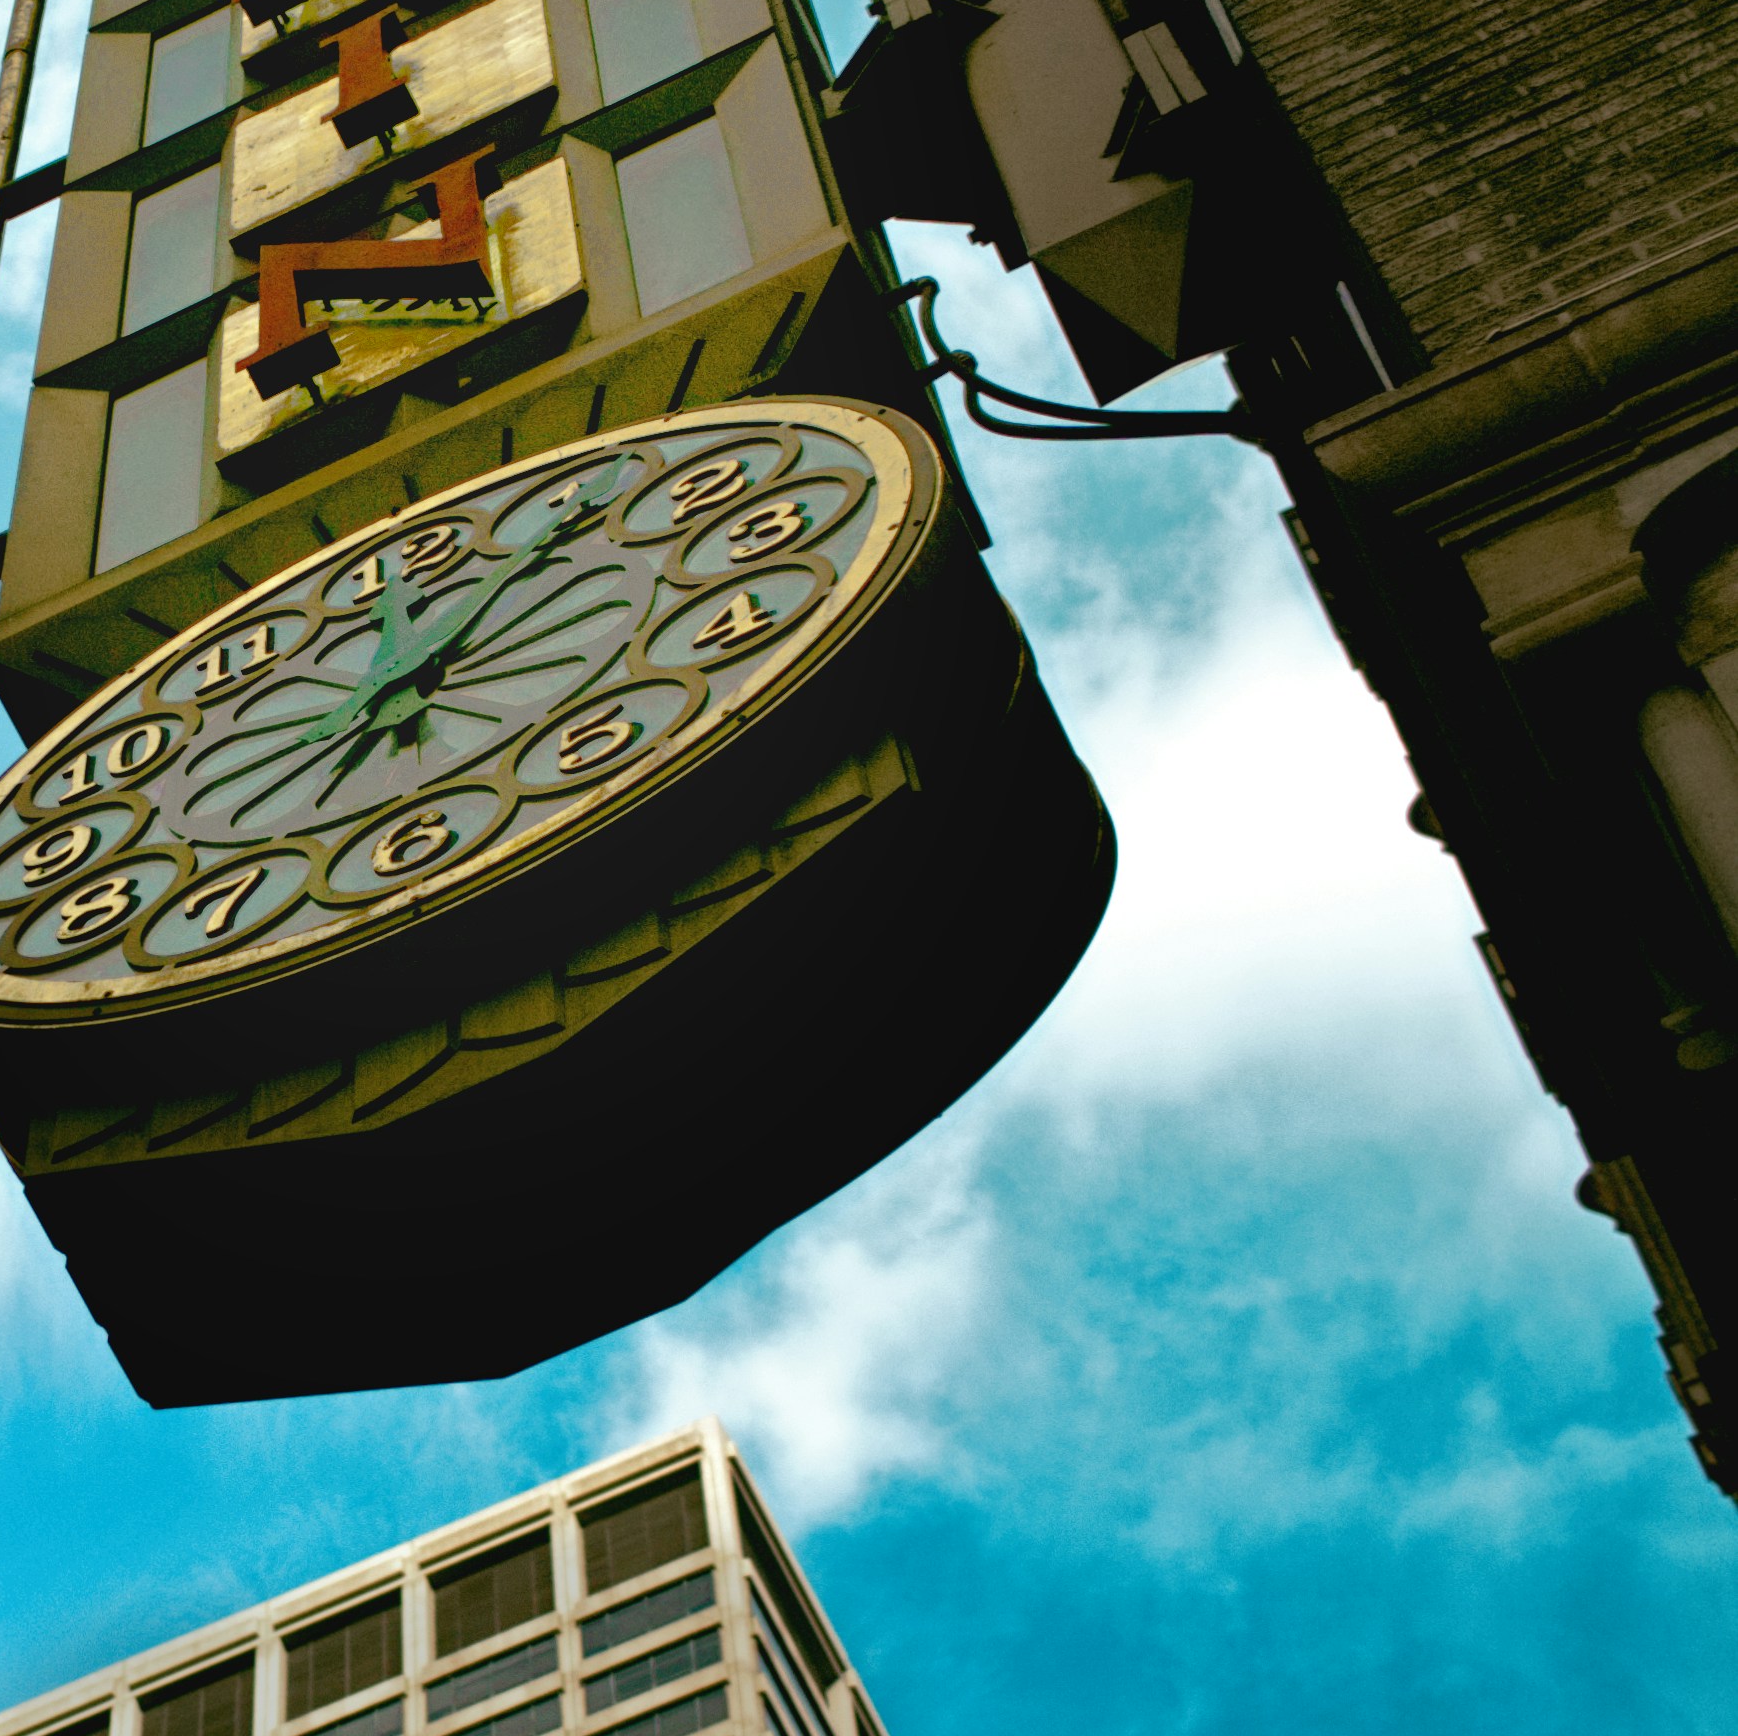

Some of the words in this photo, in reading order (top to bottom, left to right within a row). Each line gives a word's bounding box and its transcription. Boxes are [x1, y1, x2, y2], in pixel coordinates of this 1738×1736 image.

[670, 458, 746, 523] 2
[352, 524, 458, 605] 12
[729, 501, 805, 564] 3
[693, 591, 773, 650] 4
[194, 623, 281, 697] 11
[58, 724, 162, 805] 10
[559, 704, 633, 773] 5
[22, 824, 93, 886] 9
[372, 809, 450, 876] 6
[56, 876, 134, 943] 8
[184, 866, 267, 938] 7
